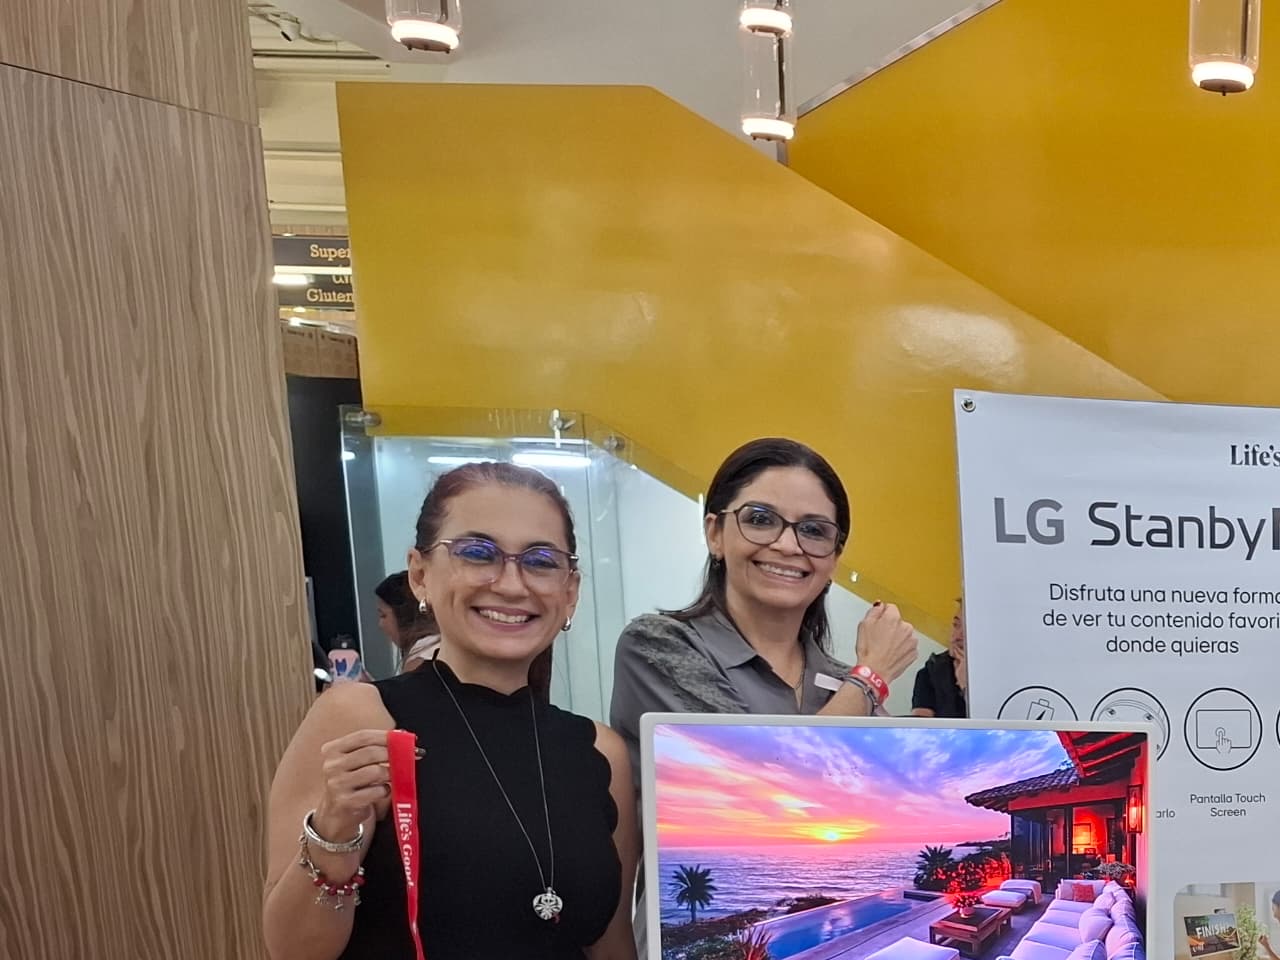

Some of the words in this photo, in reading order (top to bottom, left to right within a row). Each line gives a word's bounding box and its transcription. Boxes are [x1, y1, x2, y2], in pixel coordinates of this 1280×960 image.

[993, 496, 1065, 546] LG
[1049, 583, 1125, 602] Disfruta
[1130, 589, 1166, 603] una
[1171, 590, 1228, 604] nueva
[1042, 608, 1068, 627] de
[1071, 613, 1103, 627] ver
[1106, 611, 1126, 628] tu
[1130, 611, 1224, 629] contenido
[1106, 635, 1167, 653] donde
[1170, 636, 1239, 657] quieras
[1190, 793, 1233, 804] Pantalla
[1235, 792, 1266, 803] Touch
[396, 803, 411, 841] Life's
[1210, 807, 1247, 817] Screen
